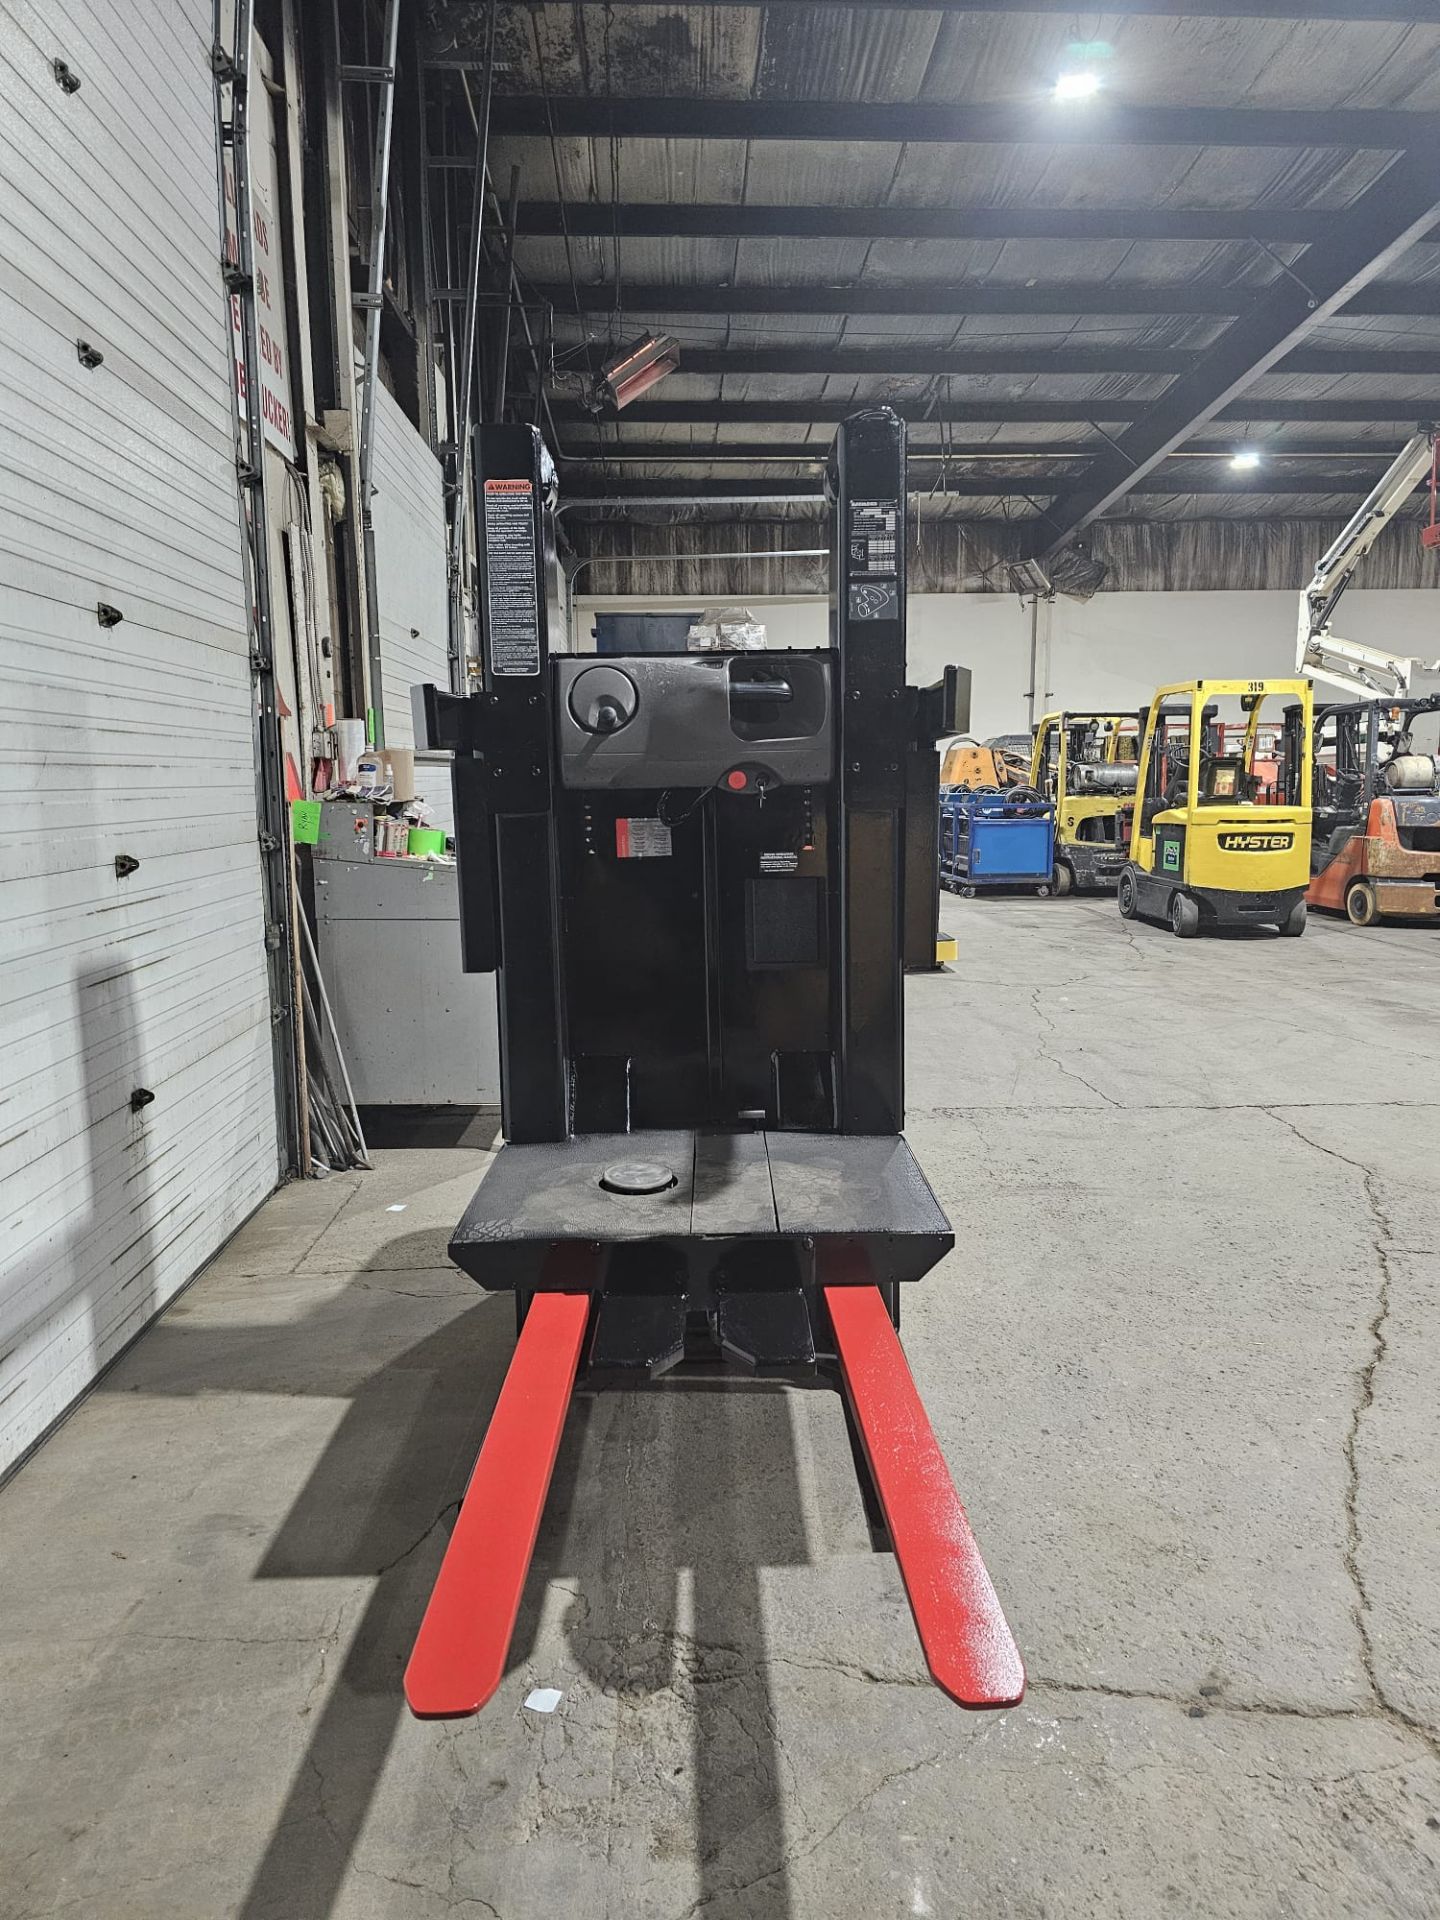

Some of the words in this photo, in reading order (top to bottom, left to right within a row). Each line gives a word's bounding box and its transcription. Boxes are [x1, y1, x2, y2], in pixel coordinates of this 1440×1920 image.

[272, 340, 283, 380] BY
[1248, 681, 1265, 692] 319
[1067, 816, 1075, 827] S
[1225, 835, 1289, 849] HYSTER
